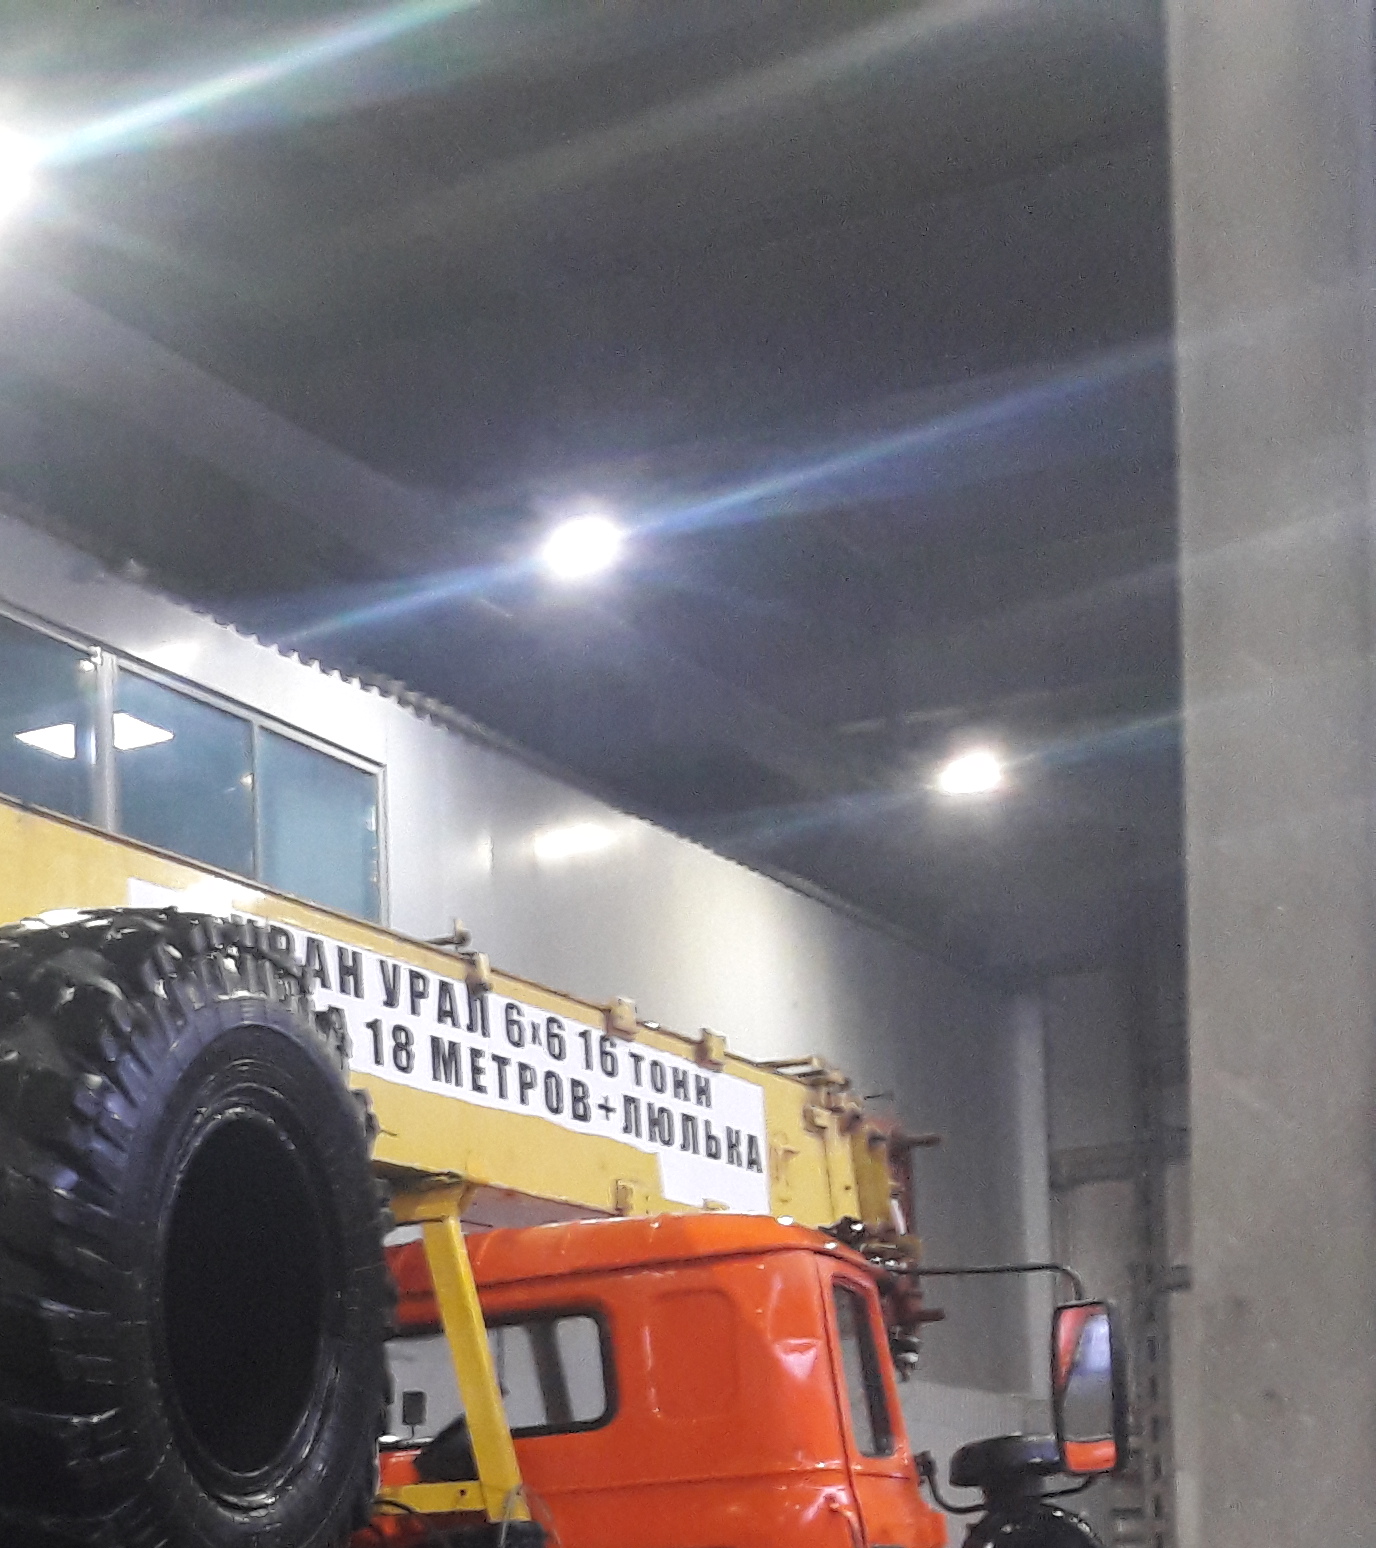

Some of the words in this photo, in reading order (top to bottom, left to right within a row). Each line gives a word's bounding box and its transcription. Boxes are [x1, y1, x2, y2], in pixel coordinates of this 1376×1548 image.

[365, 1017, 416, 1075] 18
[379, 958, 491, 1038] УРАЛ
[578, 1028, 619, 1079] 16
